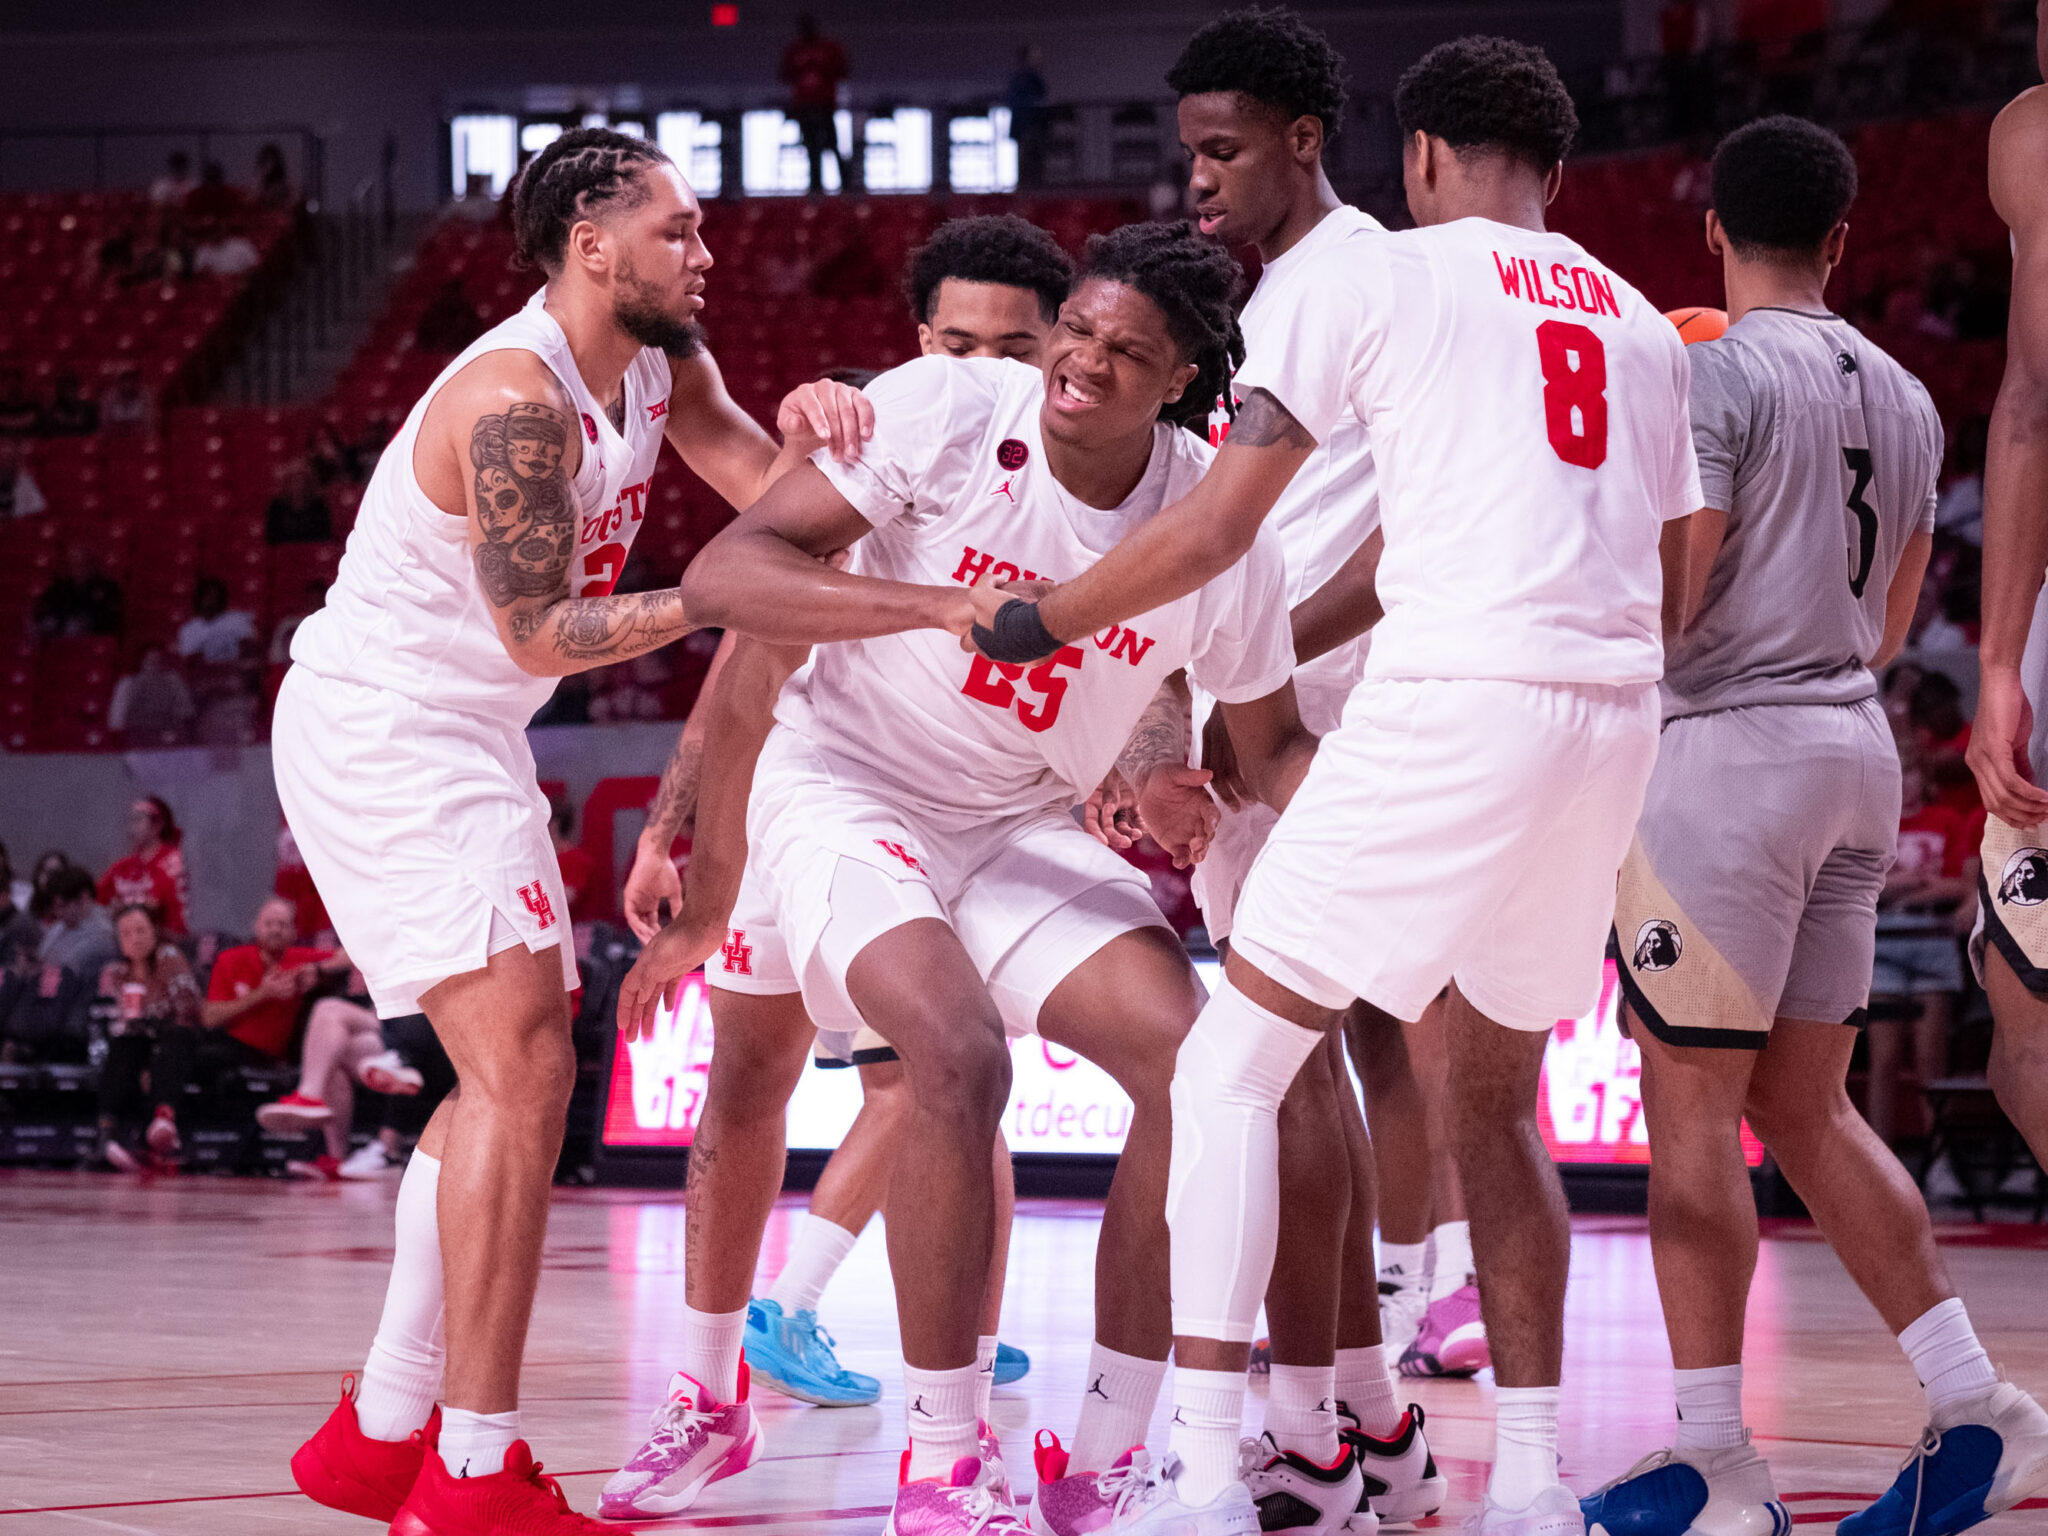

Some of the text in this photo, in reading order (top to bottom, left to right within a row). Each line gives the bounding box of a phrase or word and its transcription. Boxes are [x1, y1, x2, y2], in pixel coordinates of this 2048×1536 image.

[1493, 251, 1621, 318] WILSON
[1536, 319, 1607, 470] 8
[1002, 444, 1024, 464] 32
[1842, 447, 1879, 600] 3
[580, 542, 626, 598] 2
[516, 879, 557, 930] UH
[1015, 1089, 1130, 1138] tdecu
